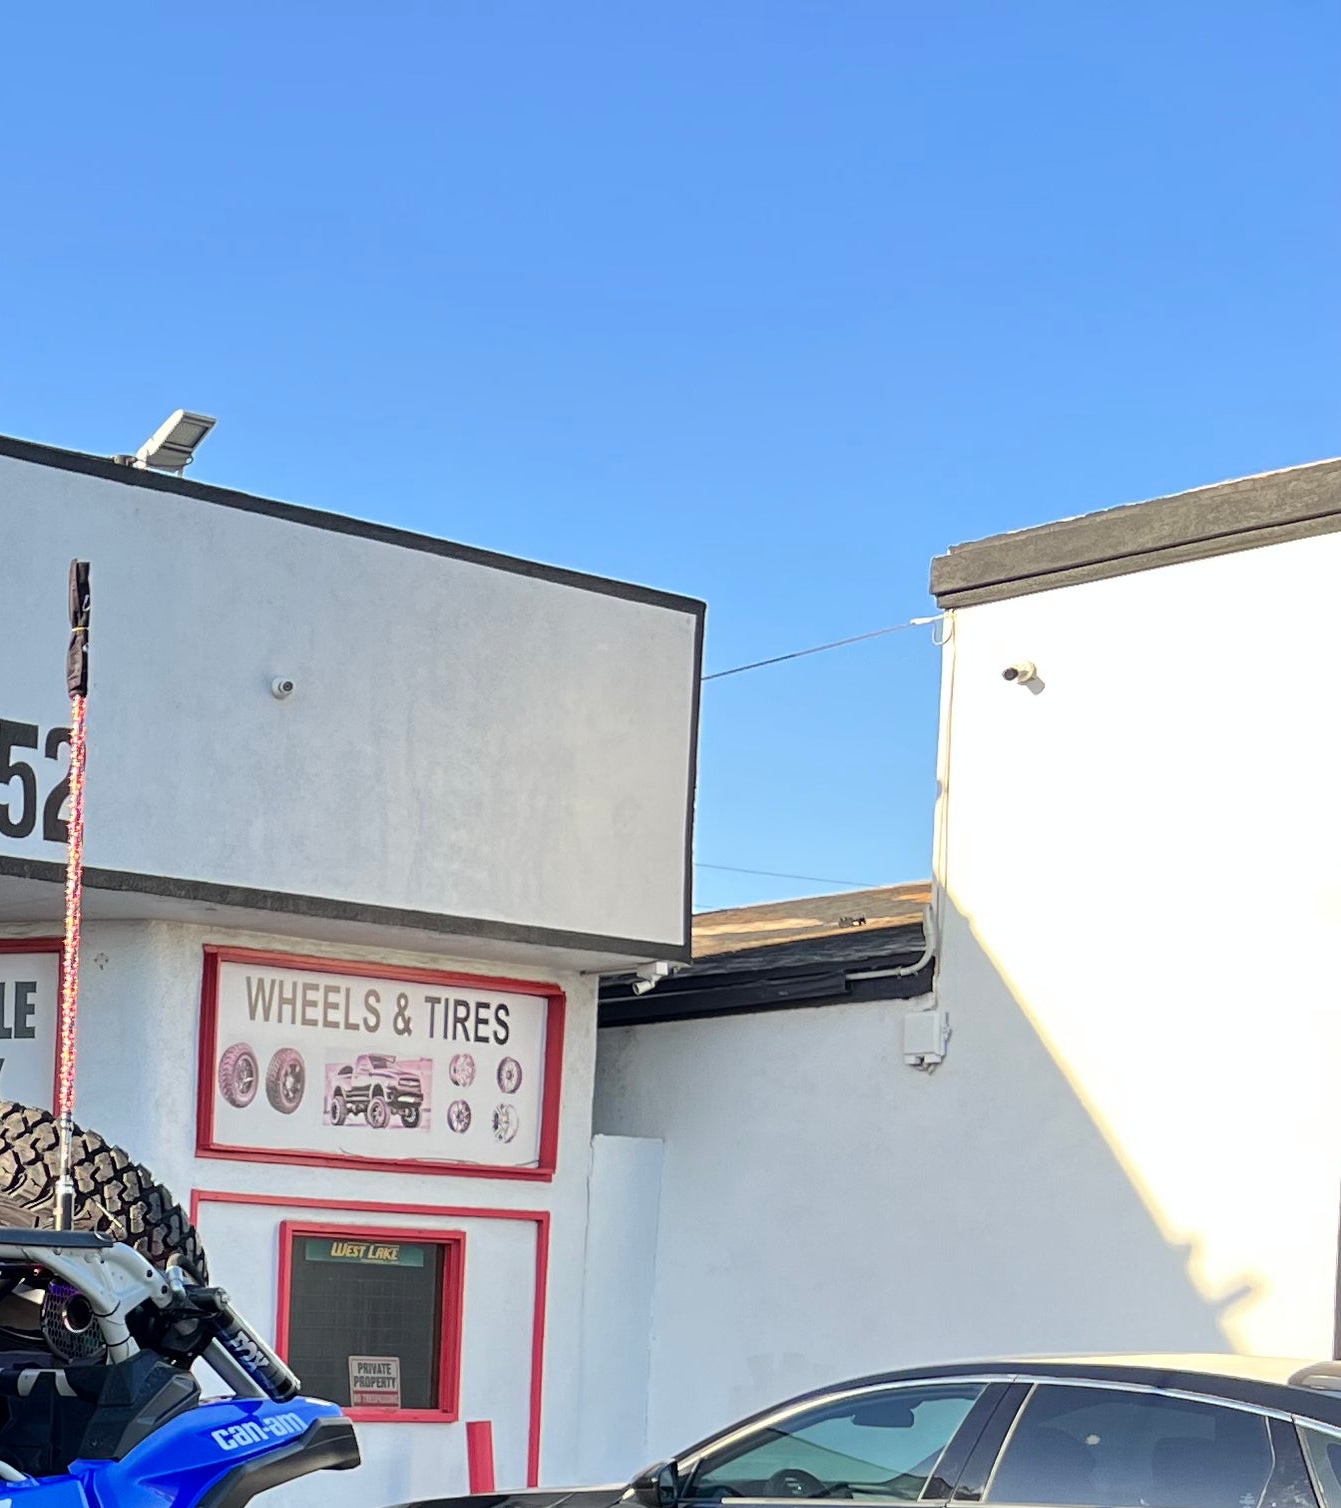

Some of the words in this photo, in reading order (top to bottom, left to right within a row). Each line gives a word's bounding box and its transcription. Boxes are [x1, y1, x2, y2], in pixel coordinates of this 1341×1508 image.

[245, 976, 382, 1034] WHEELS
[392, 992, 413, 1037] &
[424, 996, 511, 1046] TIRES
[330, 1241, 367, 1259] WEST
[367, 1244, 400, 1260] LAKE
[229, 1330, 270, 1373] FOX
[353, 1375, 396, 1389] PROPERTY
[357, 1362, 392, 1376] PRIVATE
[210, 1411, 309, 1451] can-am
